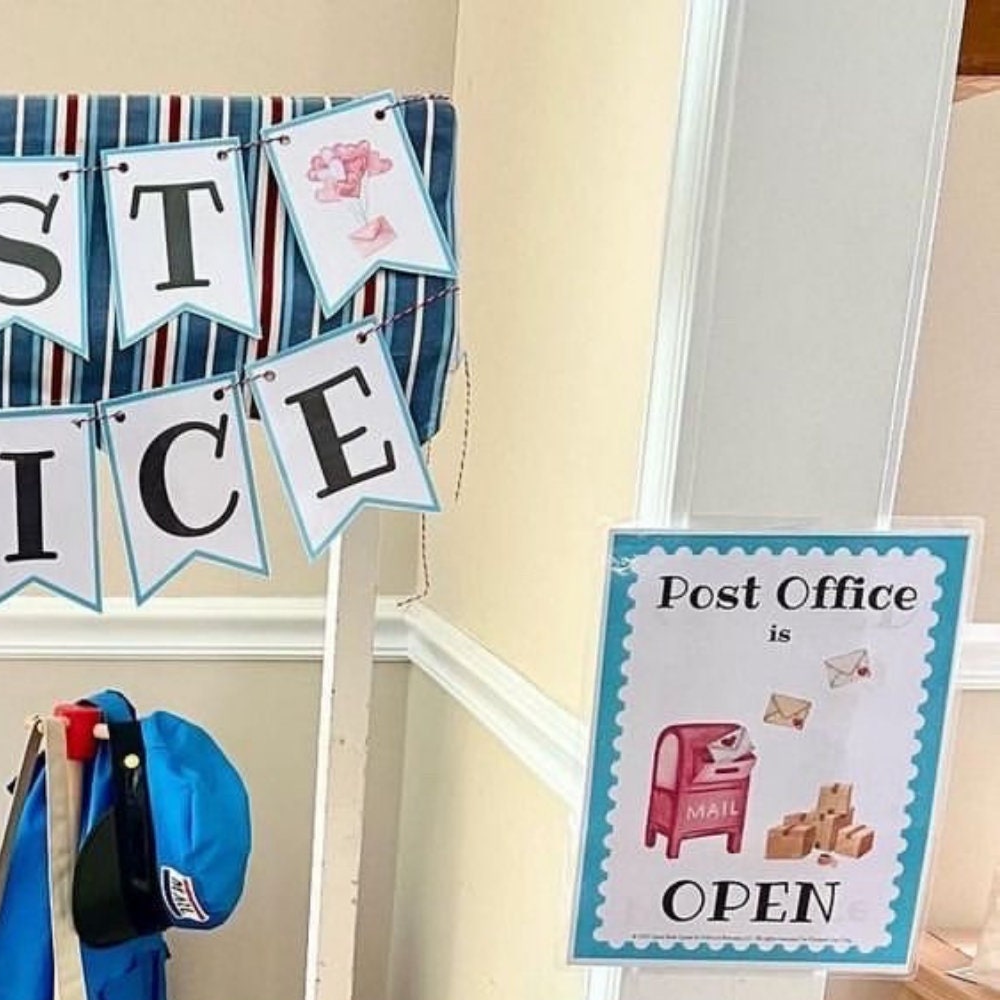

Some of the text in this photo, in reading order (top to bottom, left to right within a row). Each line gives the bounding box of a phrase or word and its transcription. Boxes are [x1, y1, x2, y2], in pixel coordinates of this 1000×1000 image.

[656, 575, 918, 611] Post Office
[769, 624, 791, 643] is
[686, 801, 740, 822] MAIL
[661, 879, 841, 924] OPEN
